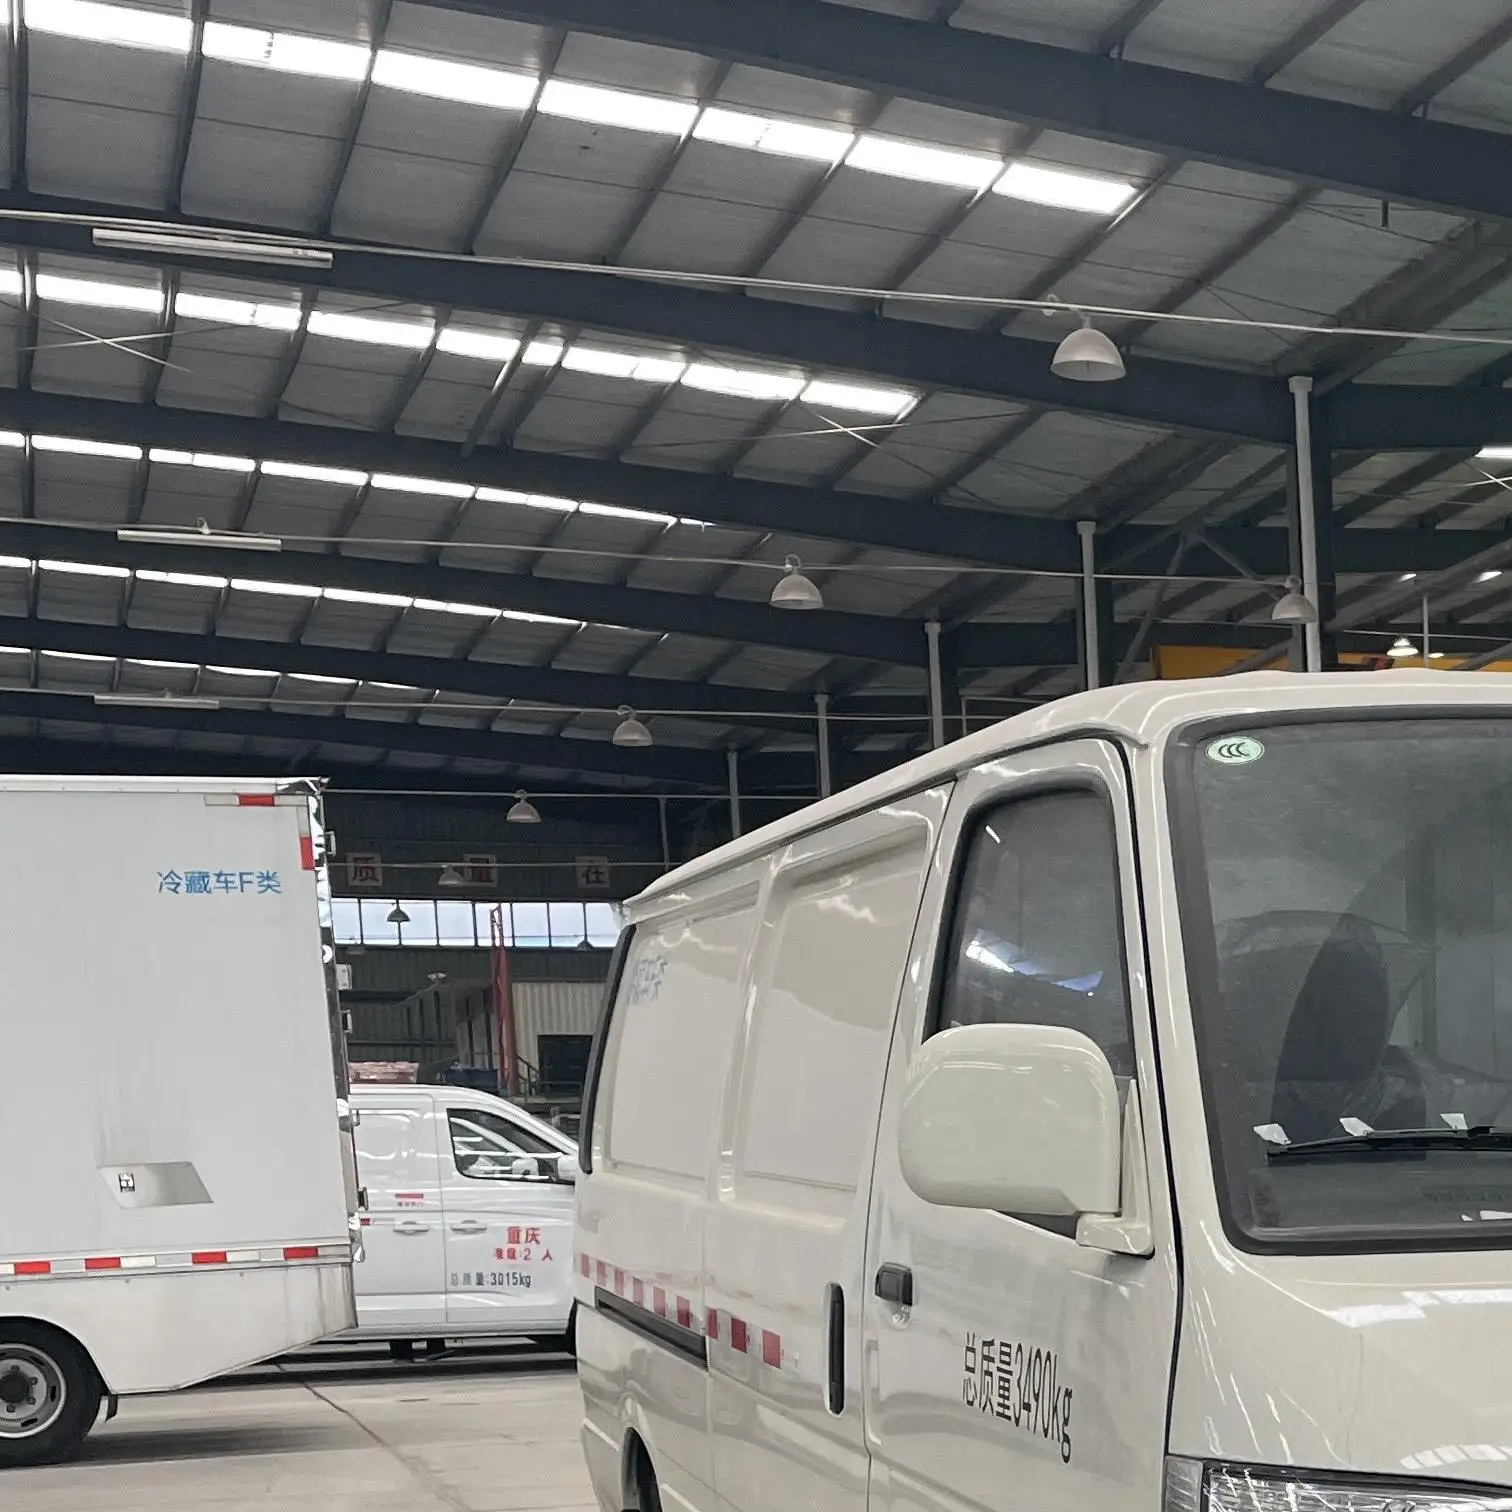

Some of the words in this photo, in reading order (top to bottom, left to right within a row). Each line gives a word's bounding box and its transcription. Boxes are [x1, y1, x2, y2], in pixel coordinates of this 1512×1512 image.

[156, 869, 283, 895] 冷藏车F类
[506, 1225, 541, 1246] 重庆
[962, 1331, 1073, 1464] 总质量3490kg
